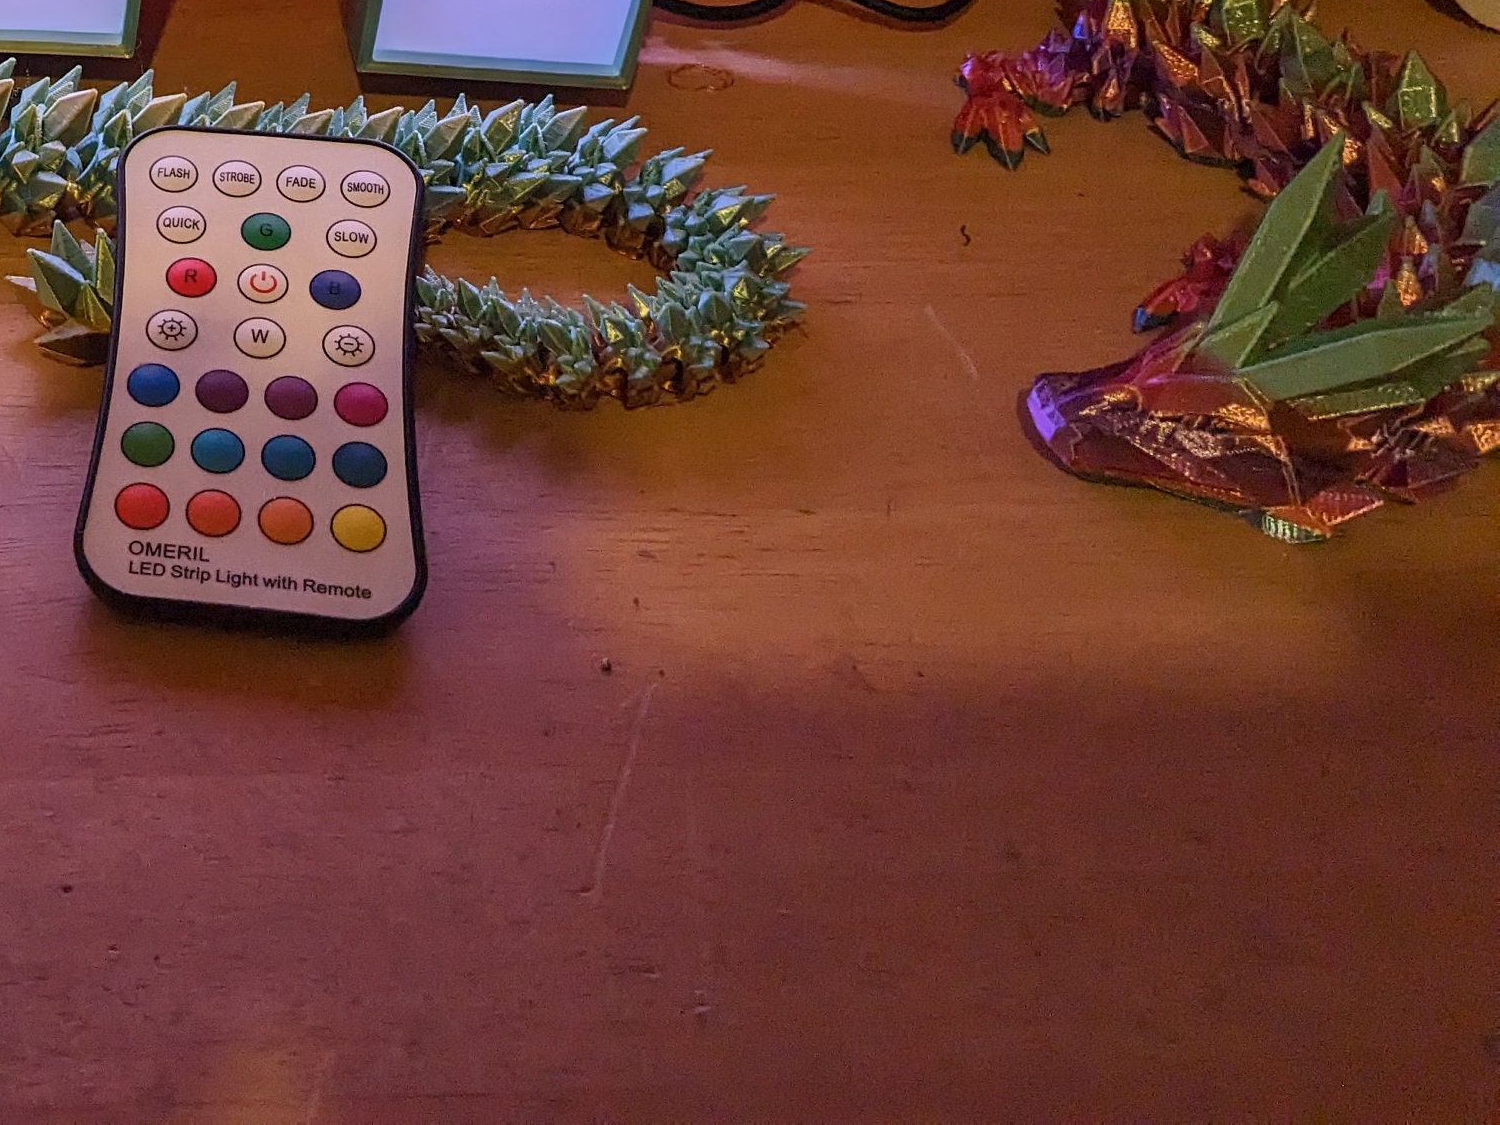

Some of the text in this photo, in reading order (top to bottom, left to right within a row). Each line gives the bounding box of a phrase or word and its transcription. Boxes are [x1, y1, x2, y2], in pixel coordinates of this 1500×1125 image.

[156, 166, 191, 180] FLASH
[218, 172, 256, 185] STROBE
[285, 176, 317, 189] FADE
[346, 181, 385, 195] SMOOTH
[162, 216, 201, 231] QUICK
[259, 223, 274, 237] G
[333, 231, 370, 244] SLOW
[184, 269, 198, 284] R
[328, 281, 340, 295] B
[251, 328, 270, 344] W
[128, 540, 210, 563] OMERIL
[128, 560, 373, 599] LED Strip Light with Remote
